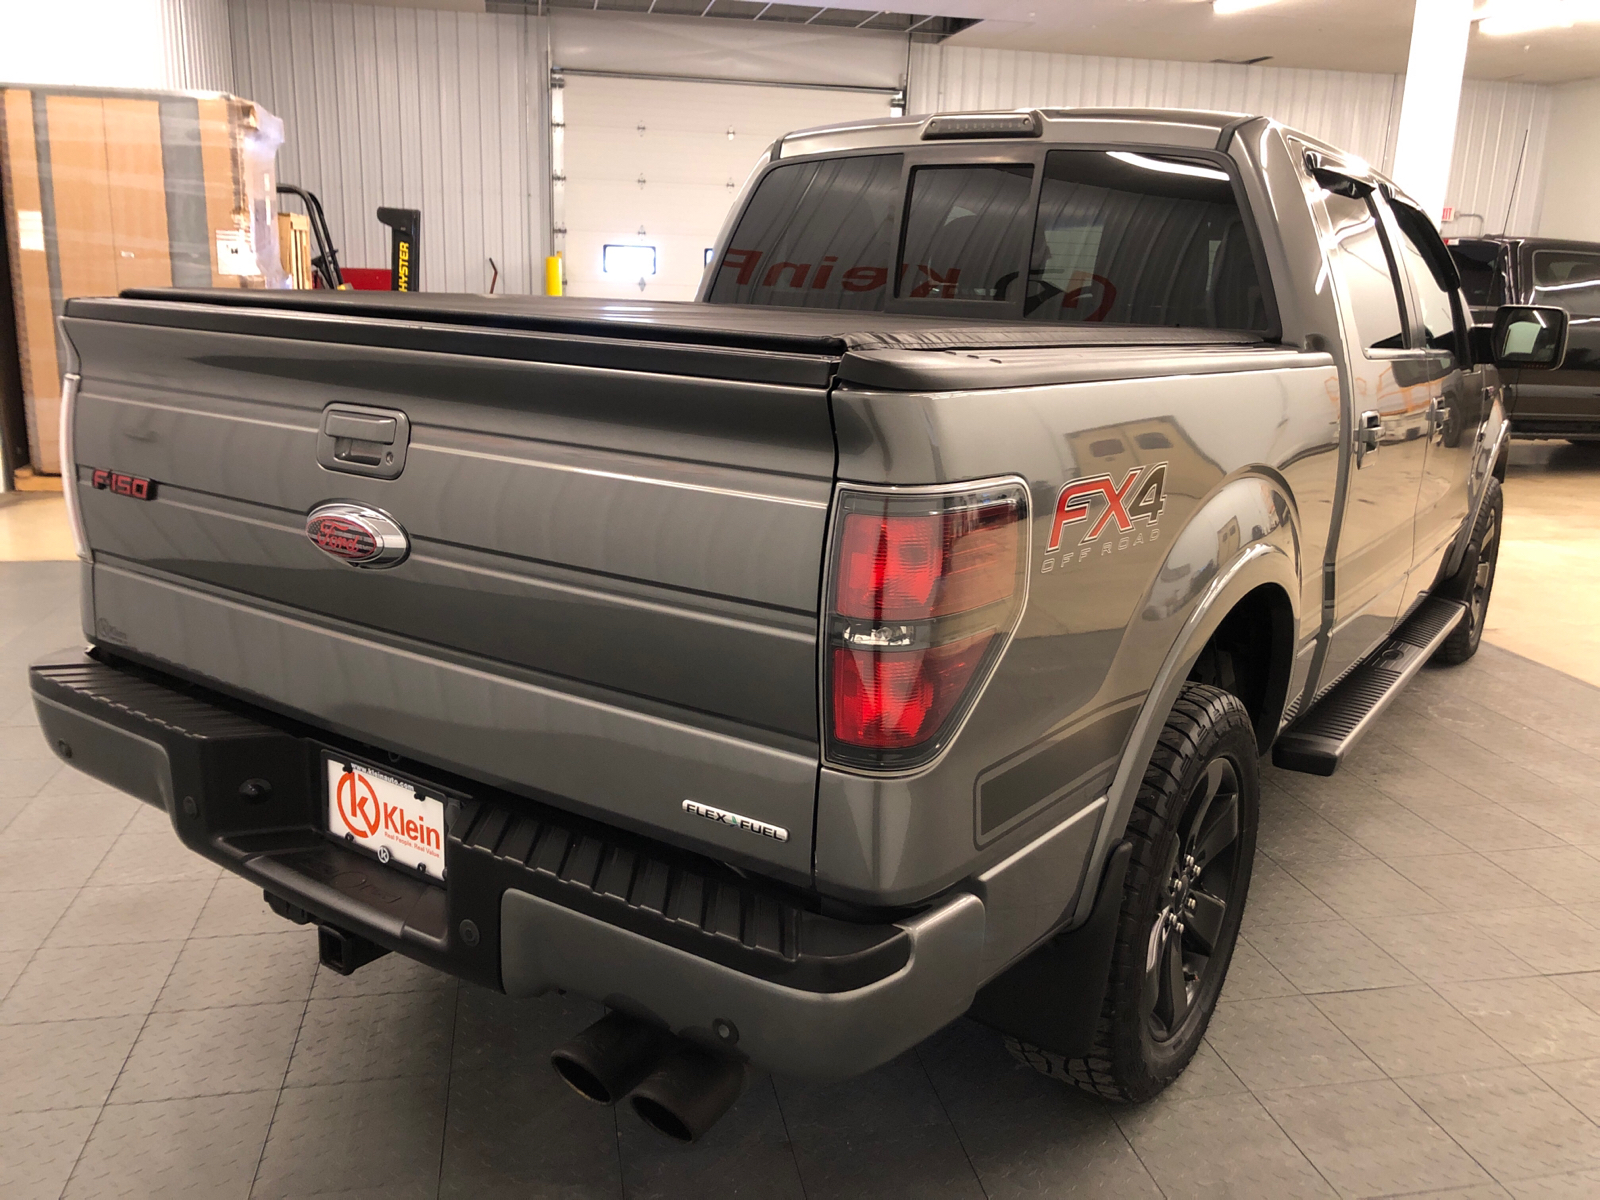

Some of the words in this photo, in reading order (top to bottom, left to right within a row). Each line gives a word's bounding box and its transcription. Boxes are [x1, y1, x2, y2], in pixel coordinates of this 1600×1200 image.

[398, 241, 409, 292] HYSTER
[1045, 461, 1168, 555] FX4
[316, 521, 360, 552] Ford
[1041, 548, 1092, 573] OFF
[1101, 528, 1160, 556] ROAD
[351, 763, 414, 791] www.kleinauto.com
[383, 801, 441, 850] Klein
[686, 803, 727, 824] FLEX
[740, 819, 784, 841] FUEL
[426, 847, 440, 858] Value
